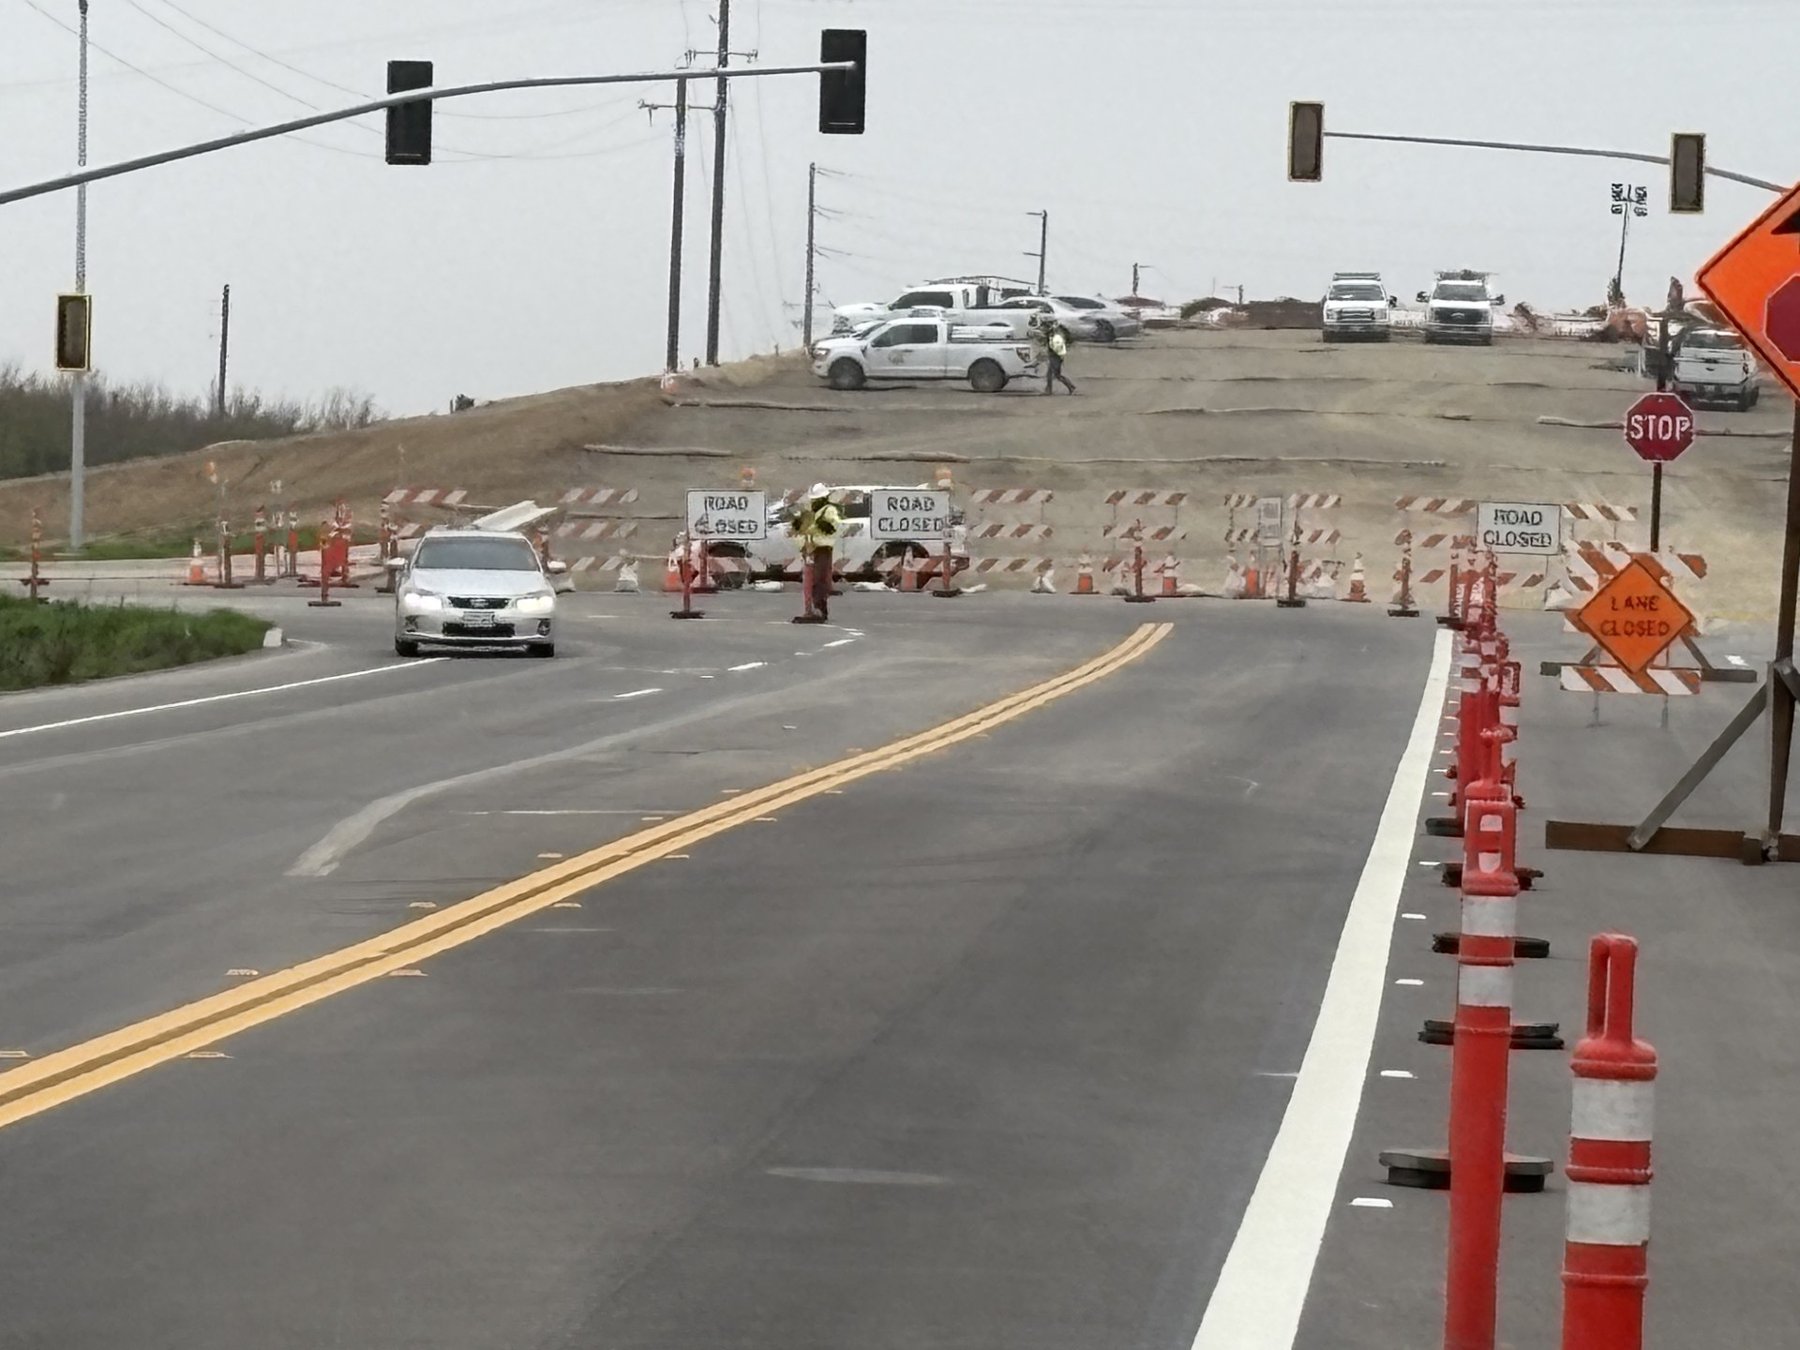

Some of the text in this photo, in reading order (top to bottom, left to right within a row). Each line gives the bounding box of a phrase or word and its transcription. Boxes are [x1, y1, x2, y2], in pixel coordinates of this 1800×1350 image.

[1630, 414, 1691, 440] STOP
[704, 496, 749, 511] ROAD
[887, 496, 935, 511] ROAD
[878, 517, 944, 532] CLOSED
[1493, 509, 1543, 526] ROAD
[694, 519, 758, 534] CLOSED
[1483, 530, 1552, 548] CLOSED
[1611, 595, 1660, 611] LANE
[1600, 620, 1670, 637] CLOSED
